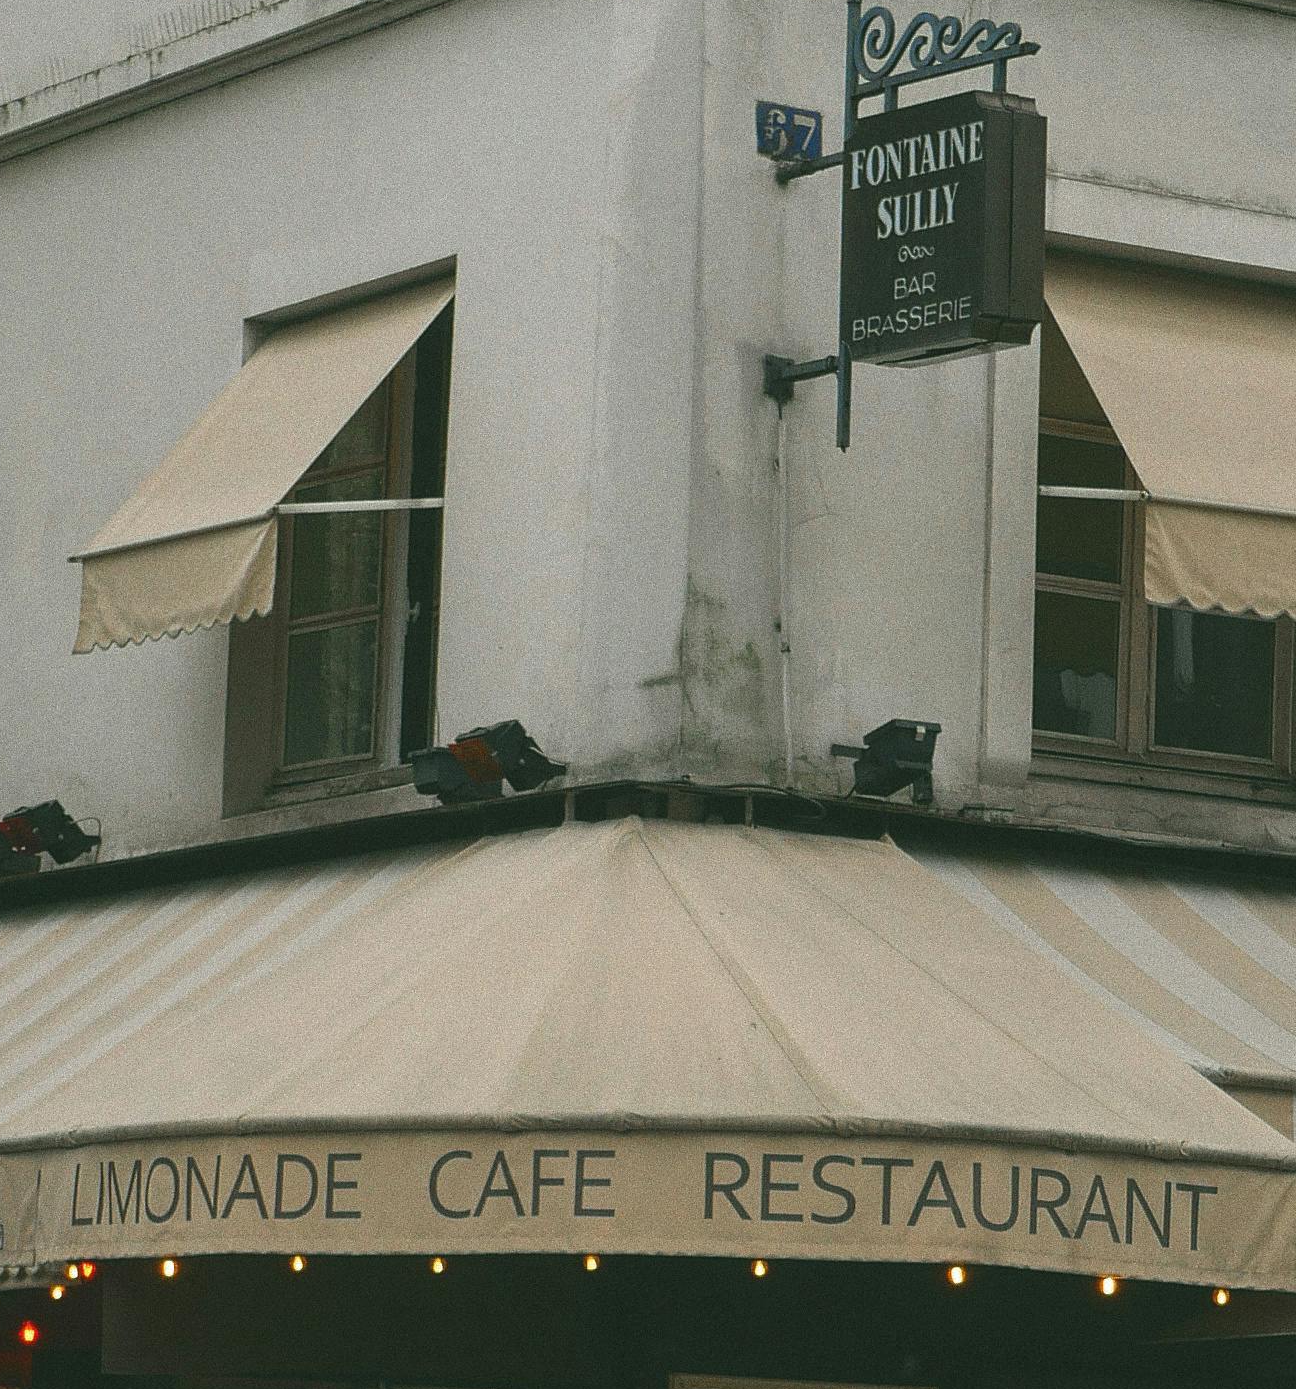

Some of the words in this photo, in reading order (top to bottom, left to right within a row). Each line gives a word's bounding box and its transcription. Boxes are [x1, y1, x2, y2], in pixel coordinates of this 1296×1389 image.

[850, 121, 984, 190] FONTAINE
[876, 183, 960, 241] SULLY
[893, 271, 937, 300] BAR
[852, 296, 972, 341] BRASSERIE
[71, 1152, 363, 1227] LIMONADE
[428, 1149, 616, 1219] CAFE
[704, 1152, 1219, 1252] RESTAURANT
